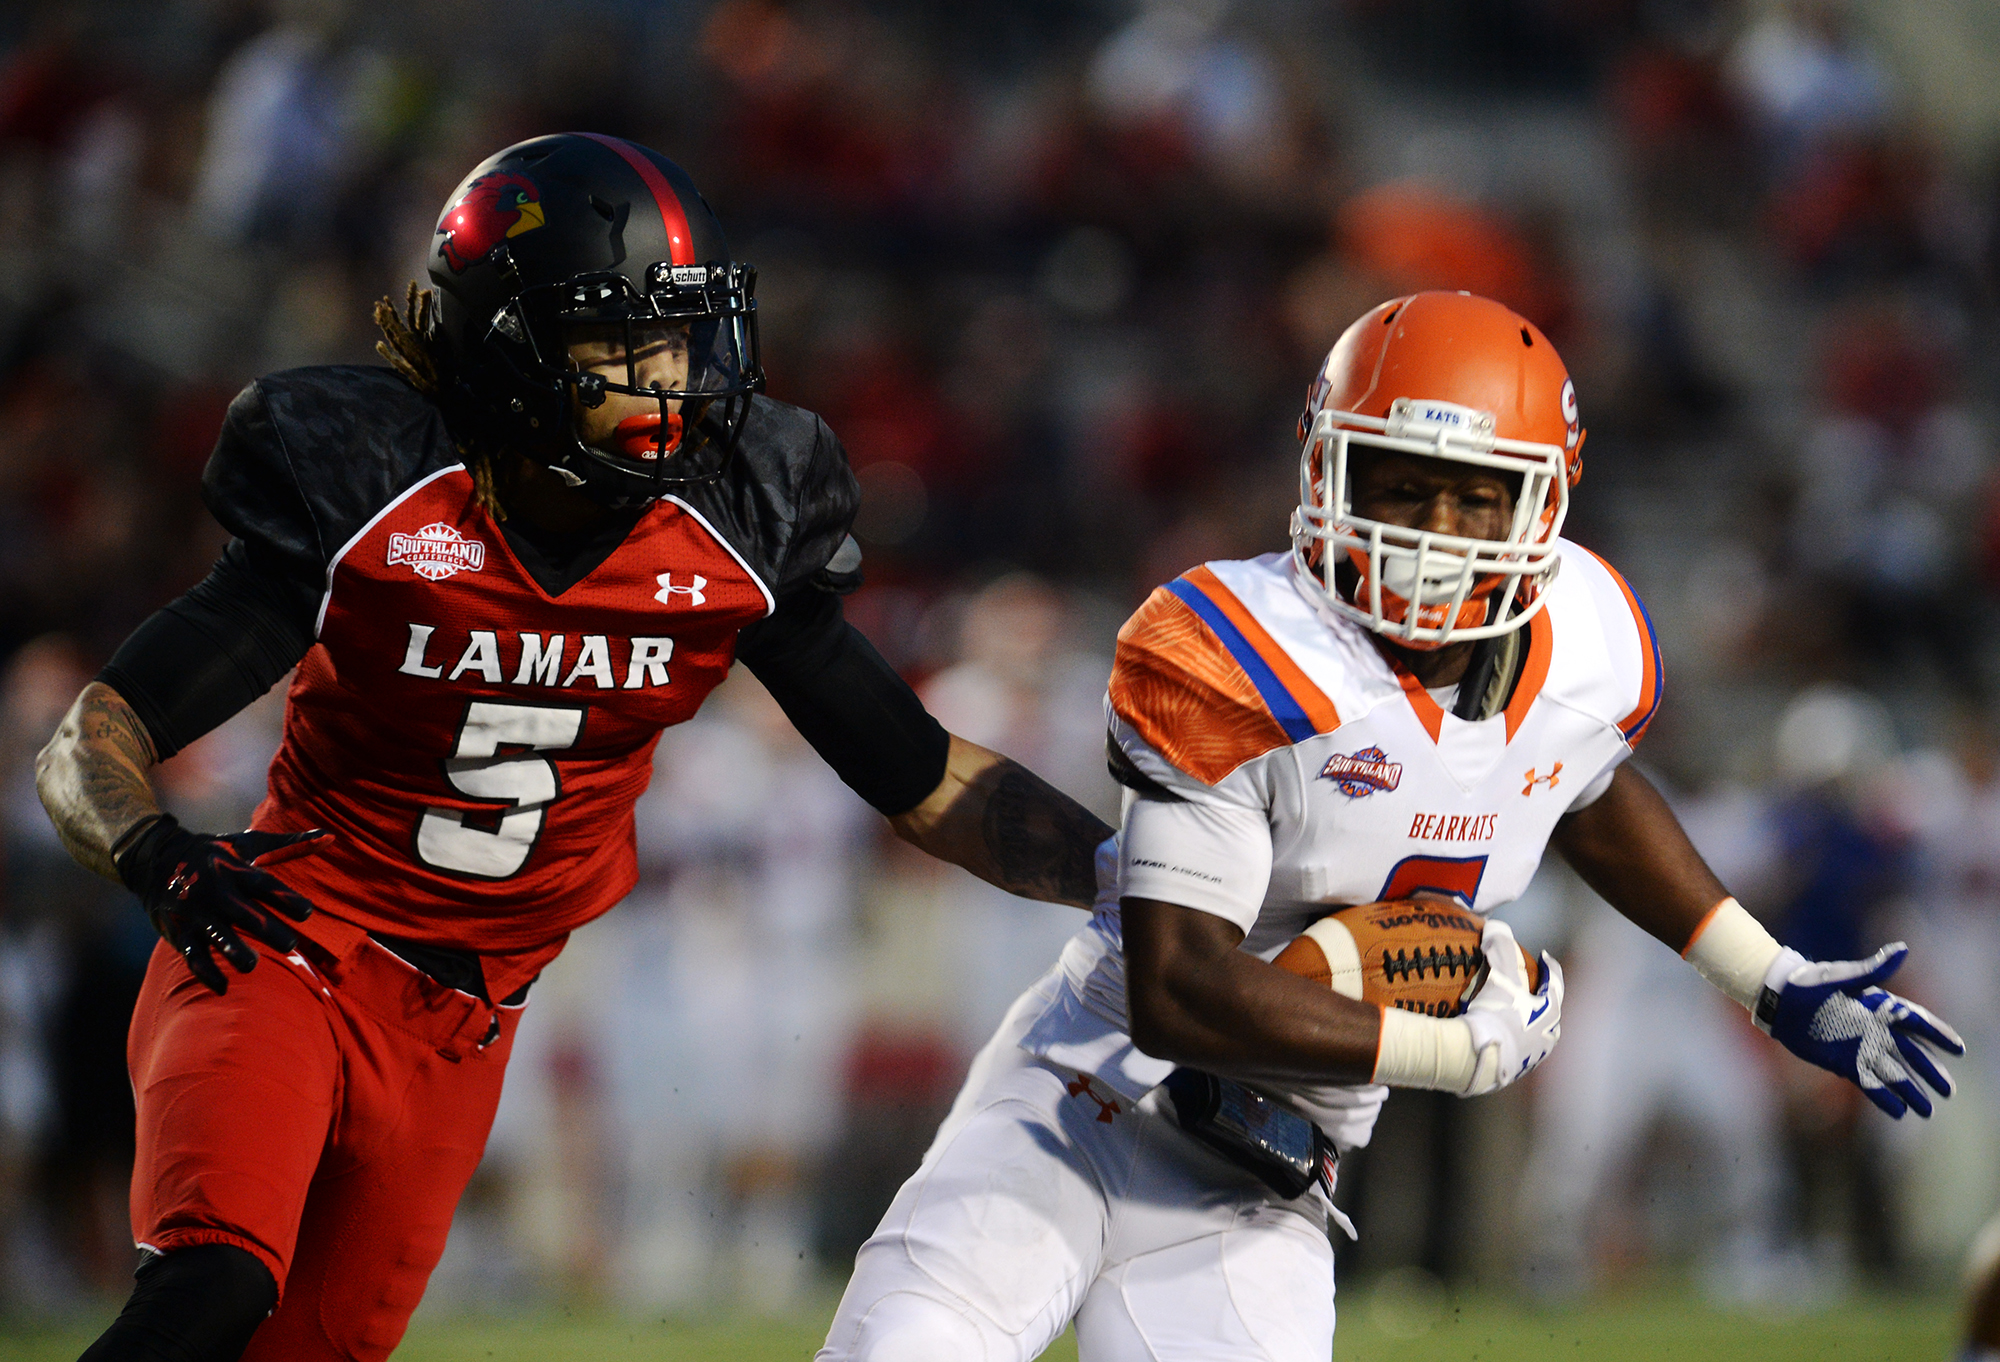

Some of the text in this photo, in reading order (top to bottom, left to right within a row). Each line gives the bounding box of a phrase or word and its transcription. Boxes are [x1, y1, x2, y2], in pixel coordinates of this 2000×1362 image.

[675, 269, 706, 282] schutt
[1425, 409, 1460, 424] KATS
[391, 536, 482, 568] SOUTHLAND
[406, 553, 466, 566] CONFERENCE
[397, 622, 676, 690] LAMAR
[1322, 755, 1402, 788] SOUTHLAND
[412, 699, 590, 881] 5
[1408, 813, 1499, 841] BEARKATS
[1378, 912, 1480, 933] Wilson
